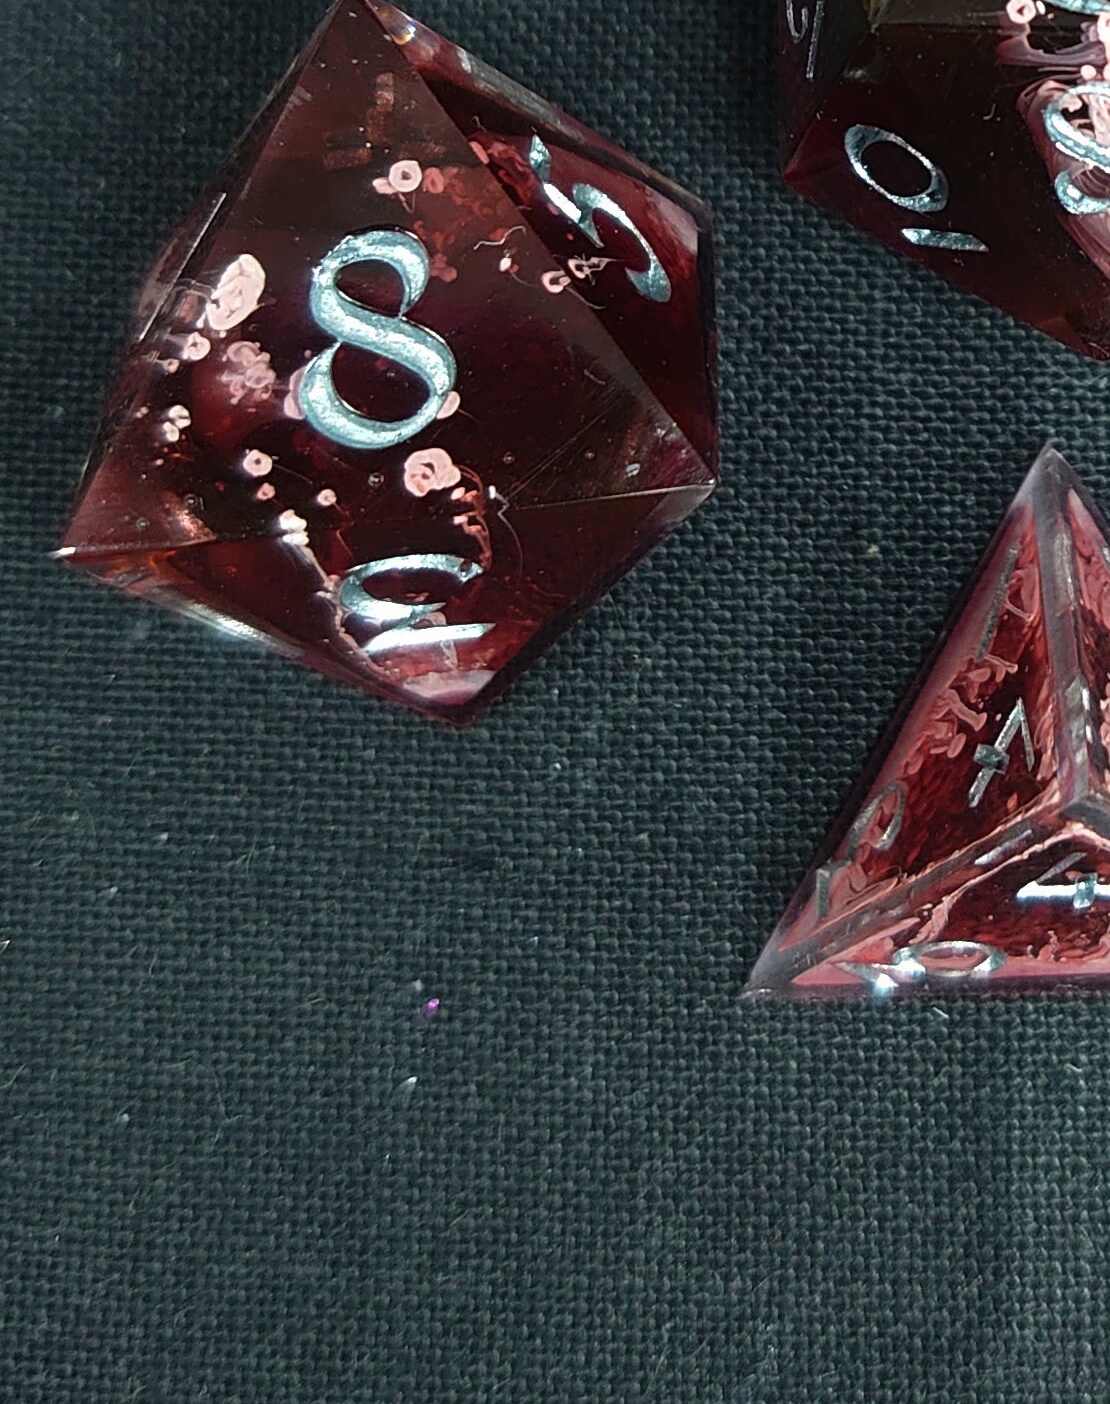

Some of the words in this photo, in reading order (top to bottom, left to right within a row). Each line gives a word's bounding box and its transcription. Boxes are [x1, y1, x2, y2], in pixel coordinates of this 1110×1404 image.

[528, 132, 672, 304] 5
[843, 123, 989, 253] 10
[299, 229, 458, 450] 8
[969, 696, 1036, 809] 4
